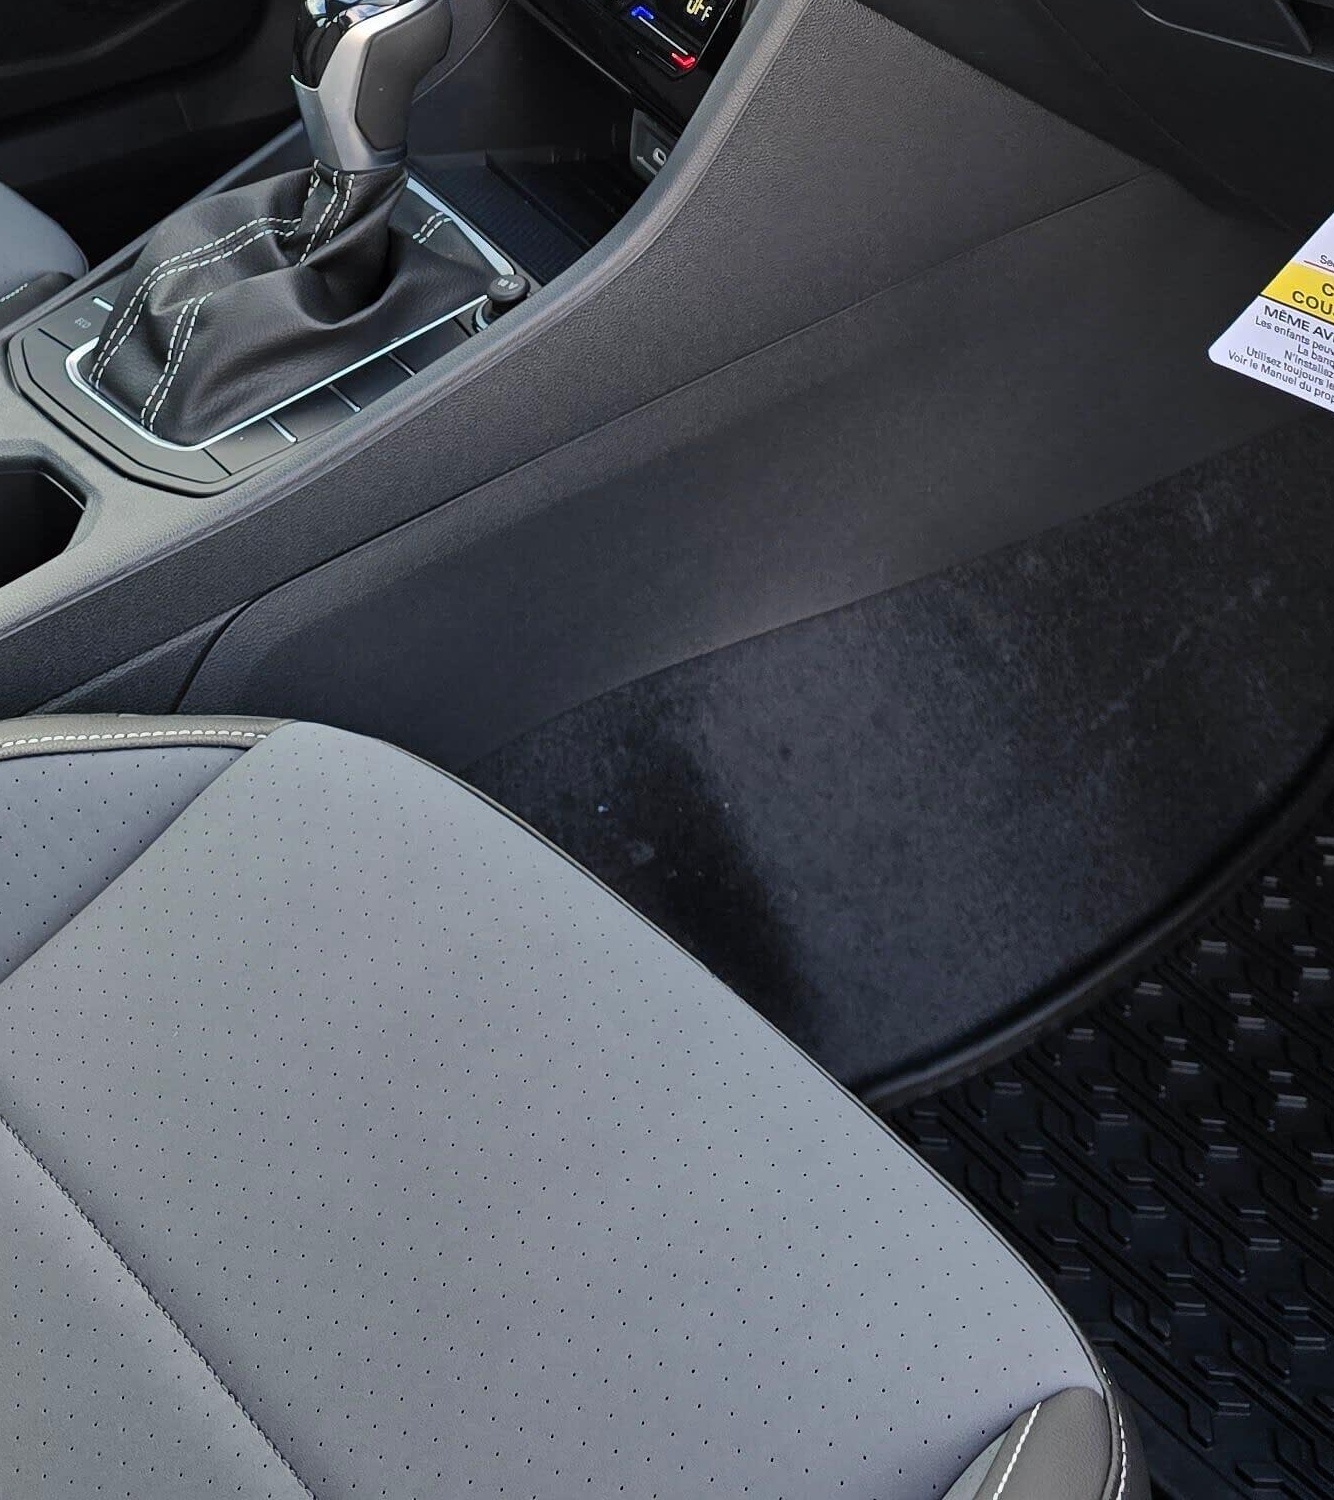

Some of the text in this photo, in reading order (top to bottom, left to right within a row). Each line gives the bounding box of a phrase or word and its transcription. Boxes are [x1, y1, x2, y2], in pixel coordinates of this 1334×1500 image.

[1255, 317, 1271, 330] Les
[1274, 324, 1310, 345] enfants
[1263, 304, 1310, 332] MÊME
[1227, 351, 1247, 366] Voir
[1260, 364, 1296, 386] Manuel
